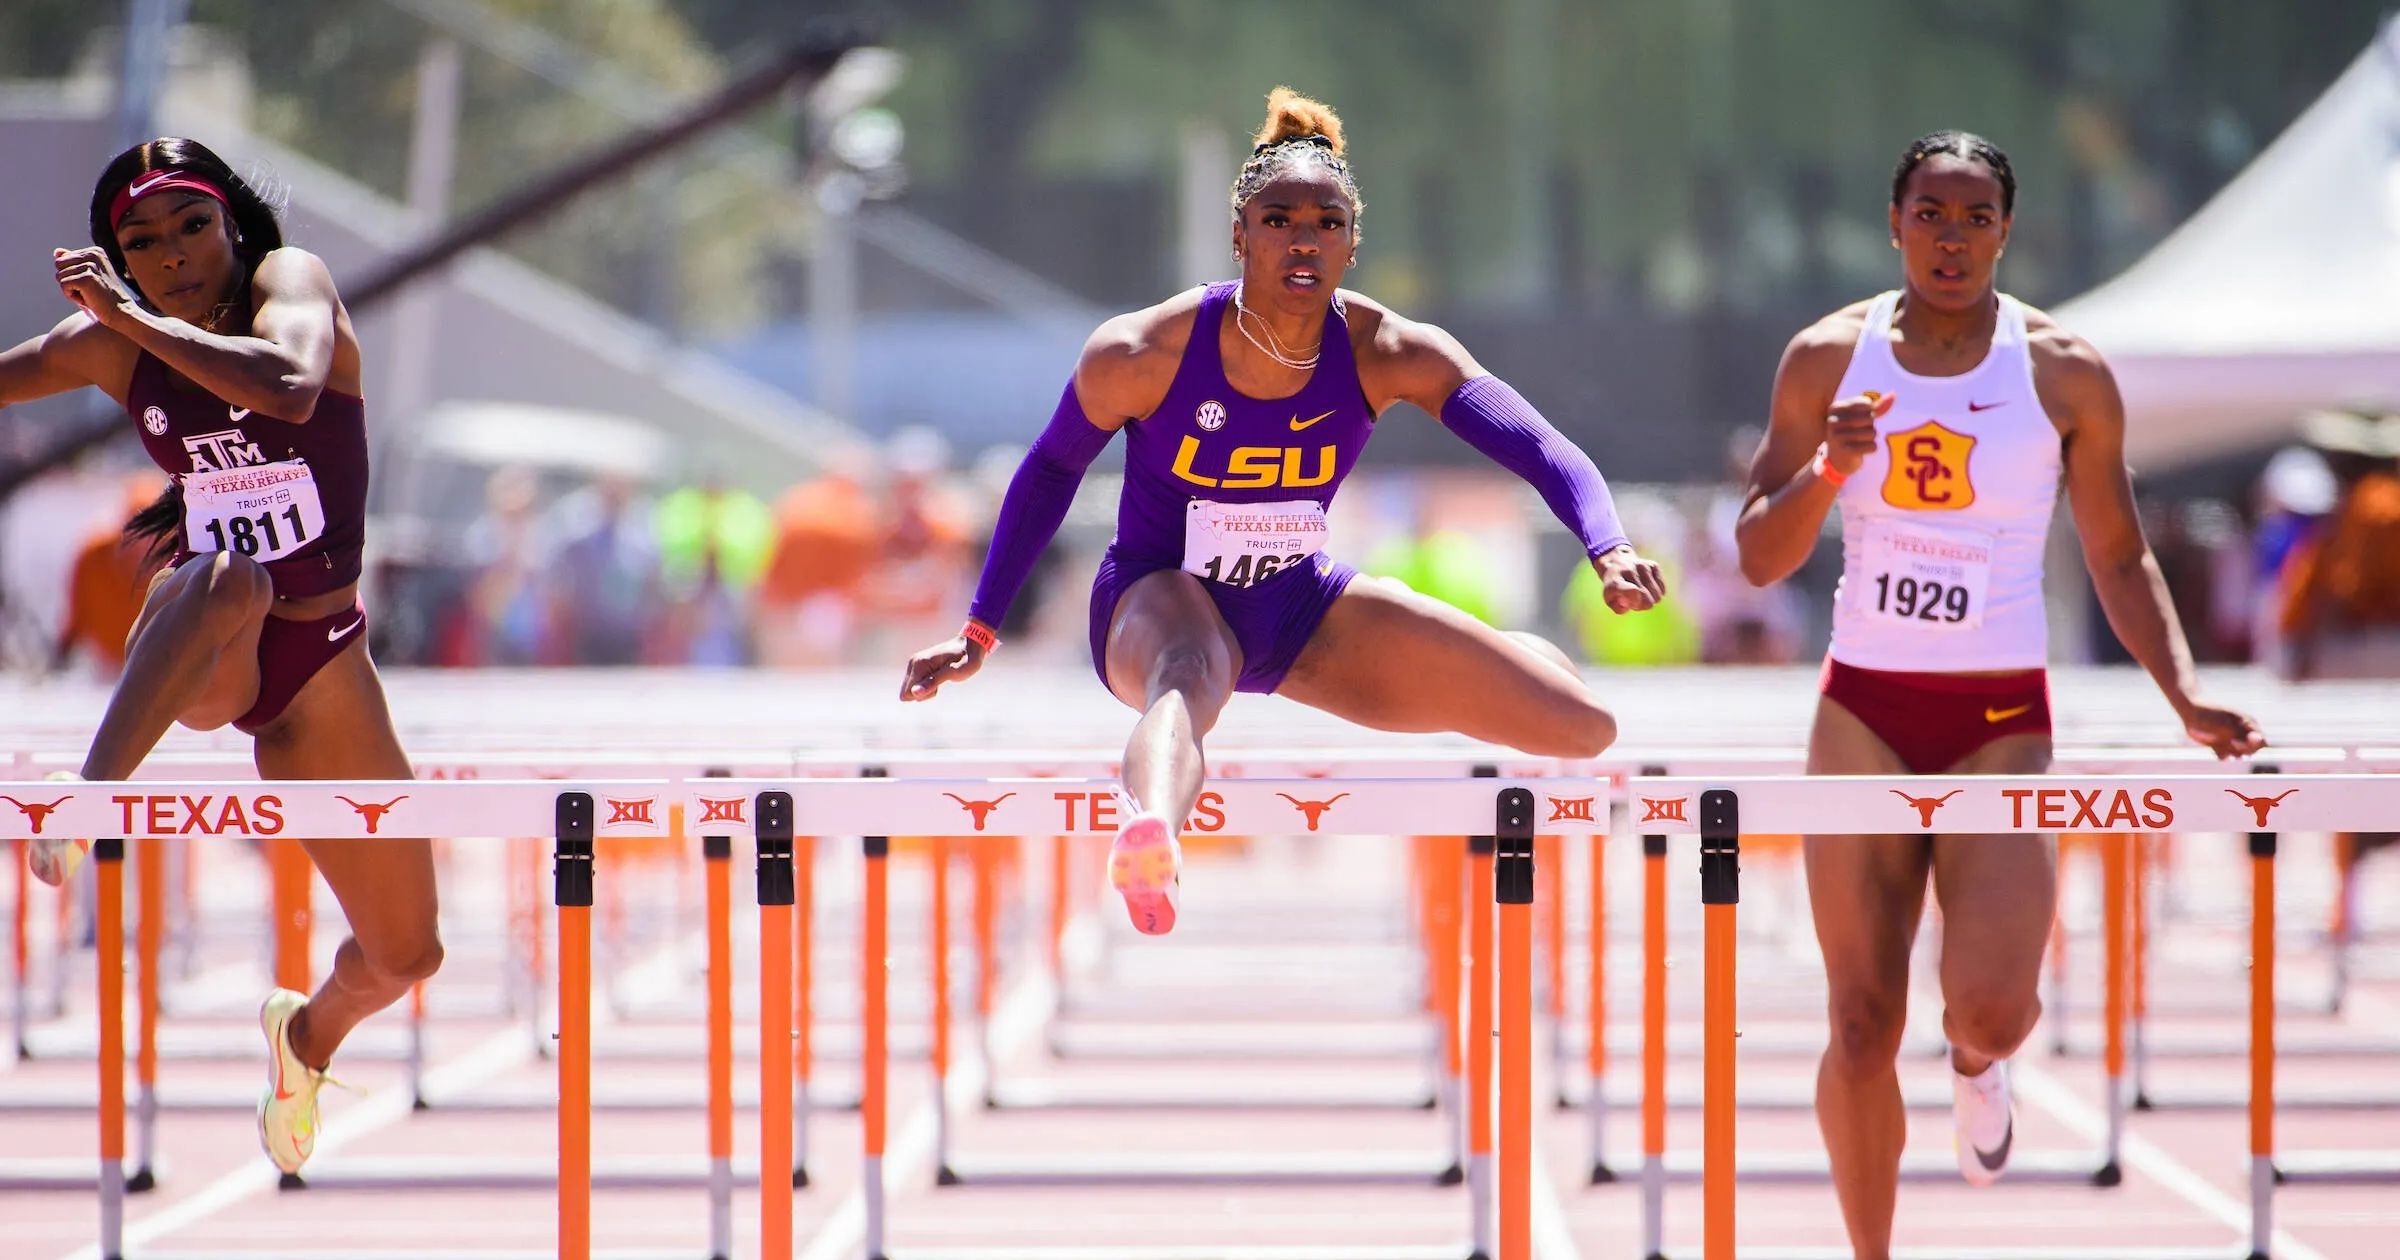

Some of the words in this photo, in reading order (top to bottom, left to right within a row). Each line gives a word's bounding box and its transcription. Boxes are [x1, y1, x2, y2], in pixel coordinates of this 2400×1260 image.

[145, 406, 167, 434] SEC
[1197, 402, 1225, 430] SEC
[1171, 435, 1337, 488] LSU
[211, 480, 256, 494] TEXAS
[257, 471, 309, 488] RELAYS
[236, 495, 274, 510] TRUIST
[205, 503, 307, 557] 1811
[1224, 522, 1272, 532] TEXAS
[1276, 521, 1327, 532] RELAYS
[1245, 540, 1286, 549] TRUIST
[1875, 573, 1969, 623] 1929
[112, 795, 284, 834] TEXAS
[606, 798, 654, 824] XII
[699, 797, 746, 823] XII
[1054, 792, 1226, 831] TES
[1547, 797, 1595, 822] XII
[1641, 797, 1688, 822] XII
[2002, 788, 2174, 828] TEXAS
